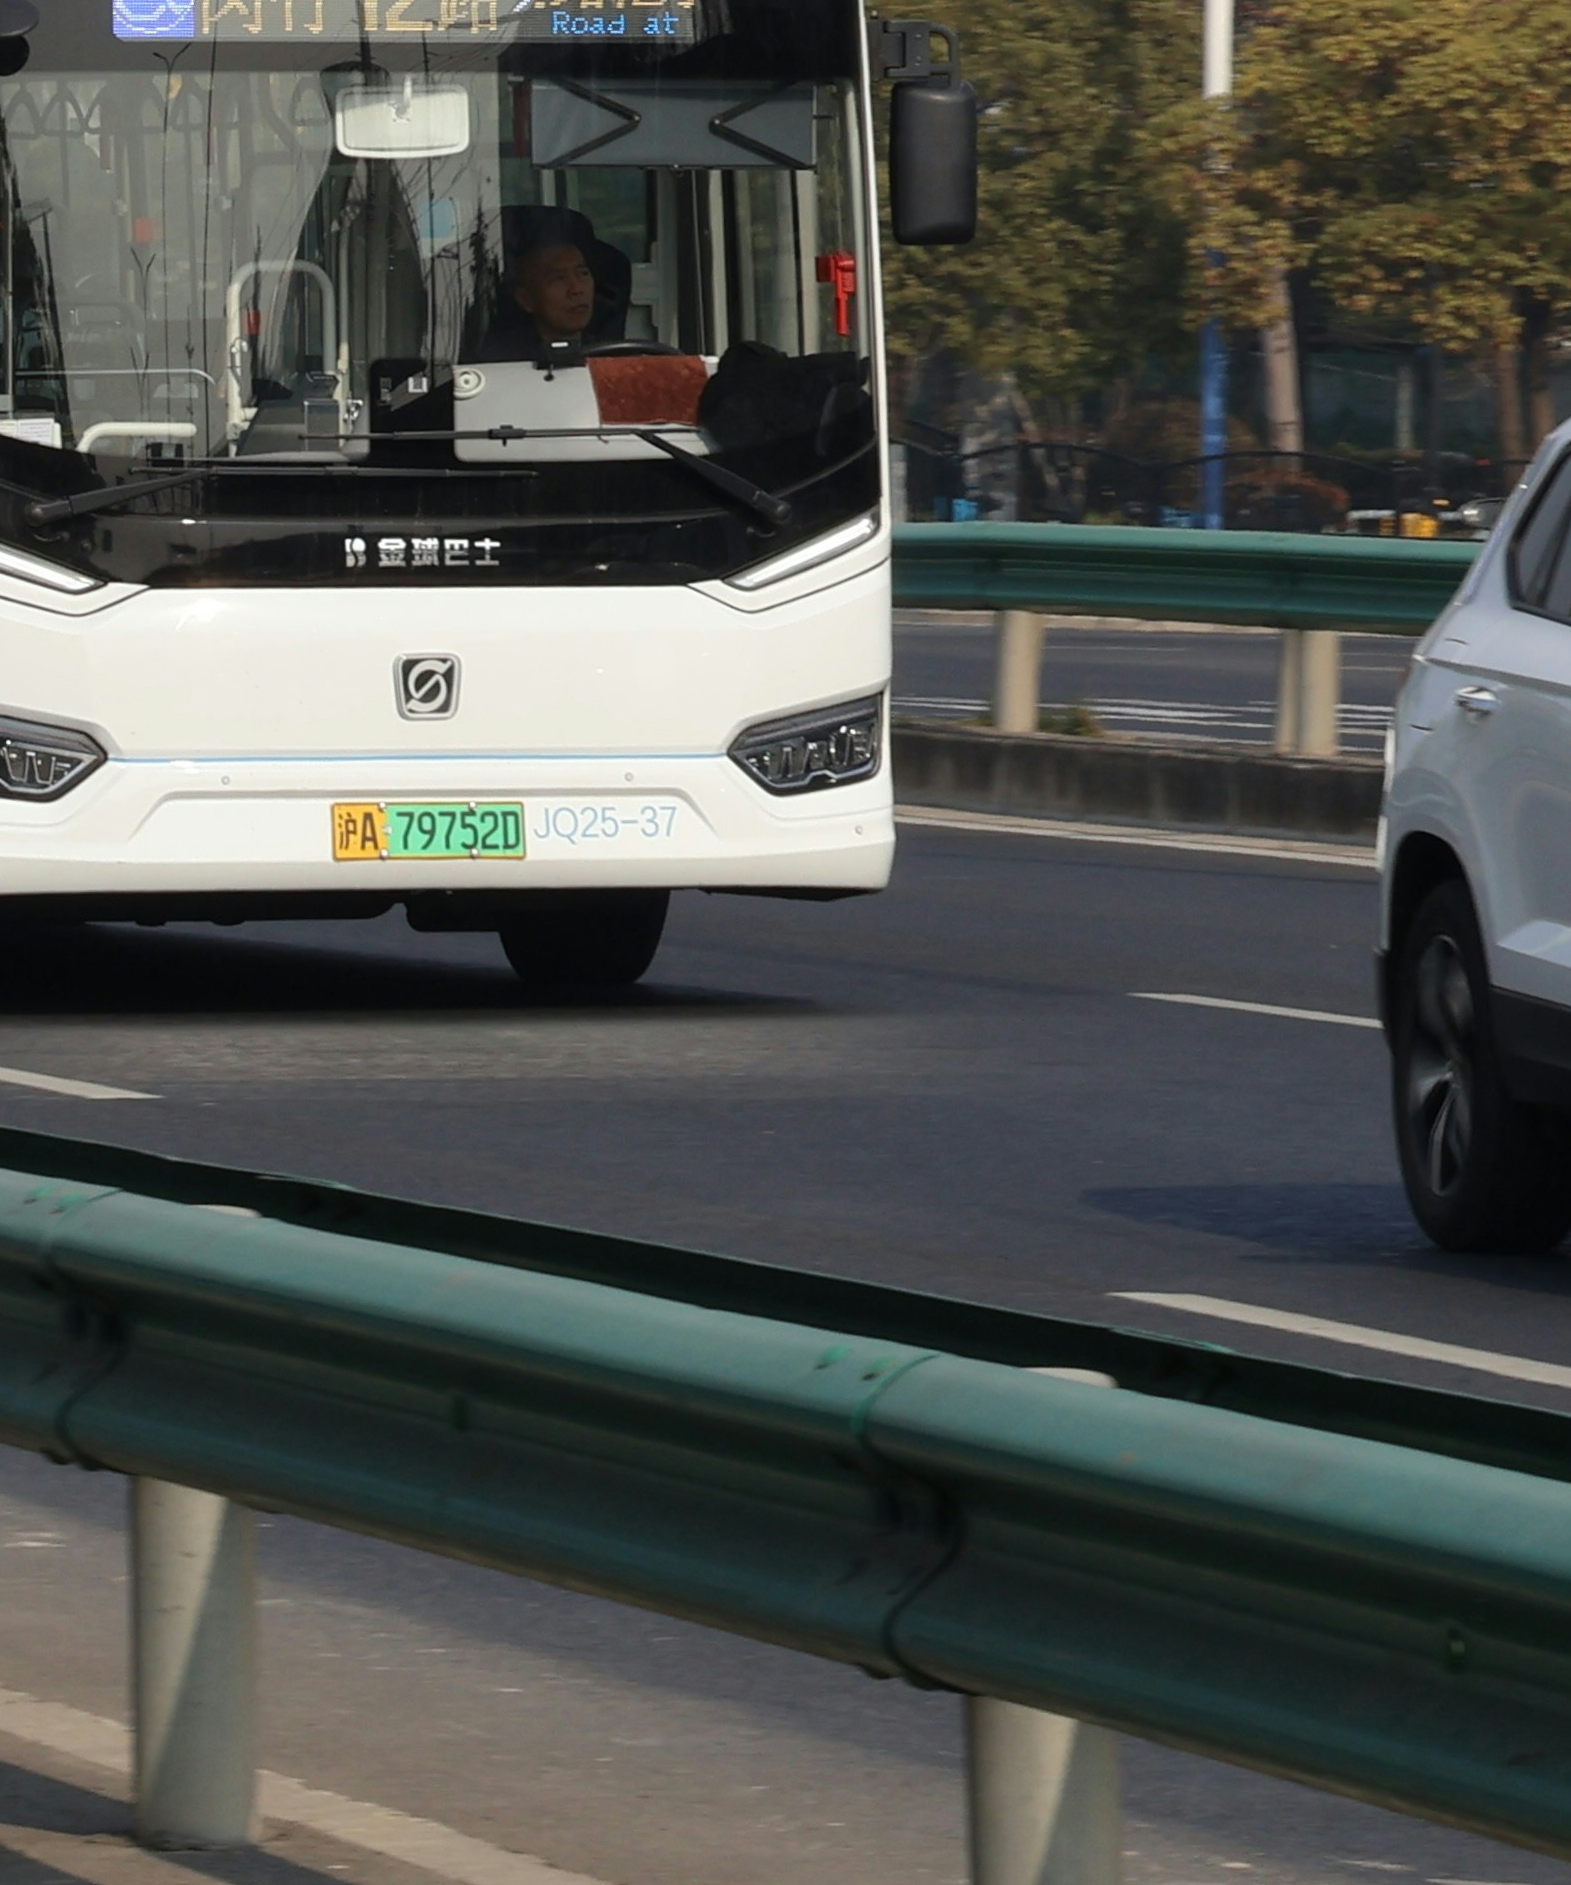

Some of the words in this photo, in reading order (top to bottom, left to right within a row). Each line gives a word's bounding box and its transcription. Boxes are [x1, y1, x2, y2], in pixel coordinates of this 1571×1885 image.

[551, 11, 626, 35] Road
[643, 11, 680, 35] at
[533, 806, 678, 845] JQ25-37
